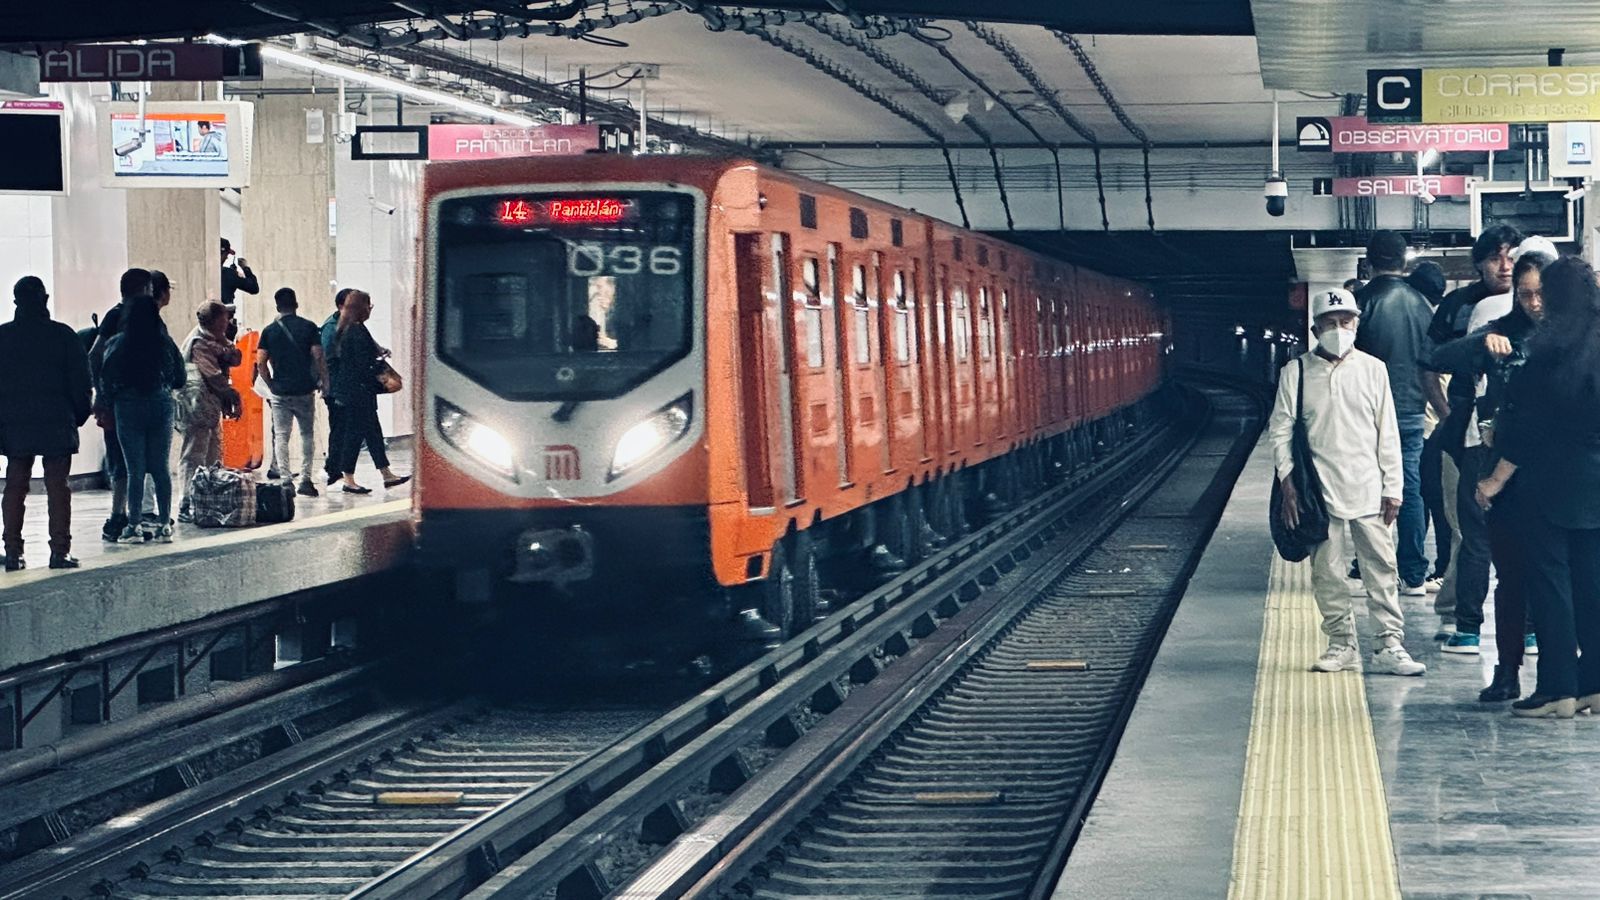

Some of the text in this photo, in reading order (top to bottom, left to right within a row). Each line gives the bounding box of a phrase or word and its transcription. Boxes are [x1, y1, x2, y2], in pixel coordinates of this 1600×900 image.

[45, 49, 176, 78] ALIDA
[1376, 75, 1411, 111] C
[455, 138, 572, 153] PANTITLAN
[1338, 128, 1502, 145] OBSERVATORIO
[1357, 180, 1441, 195] SALIDA
[502, 201, 527, 220] 14
[571, 245, 682, 277] 036
